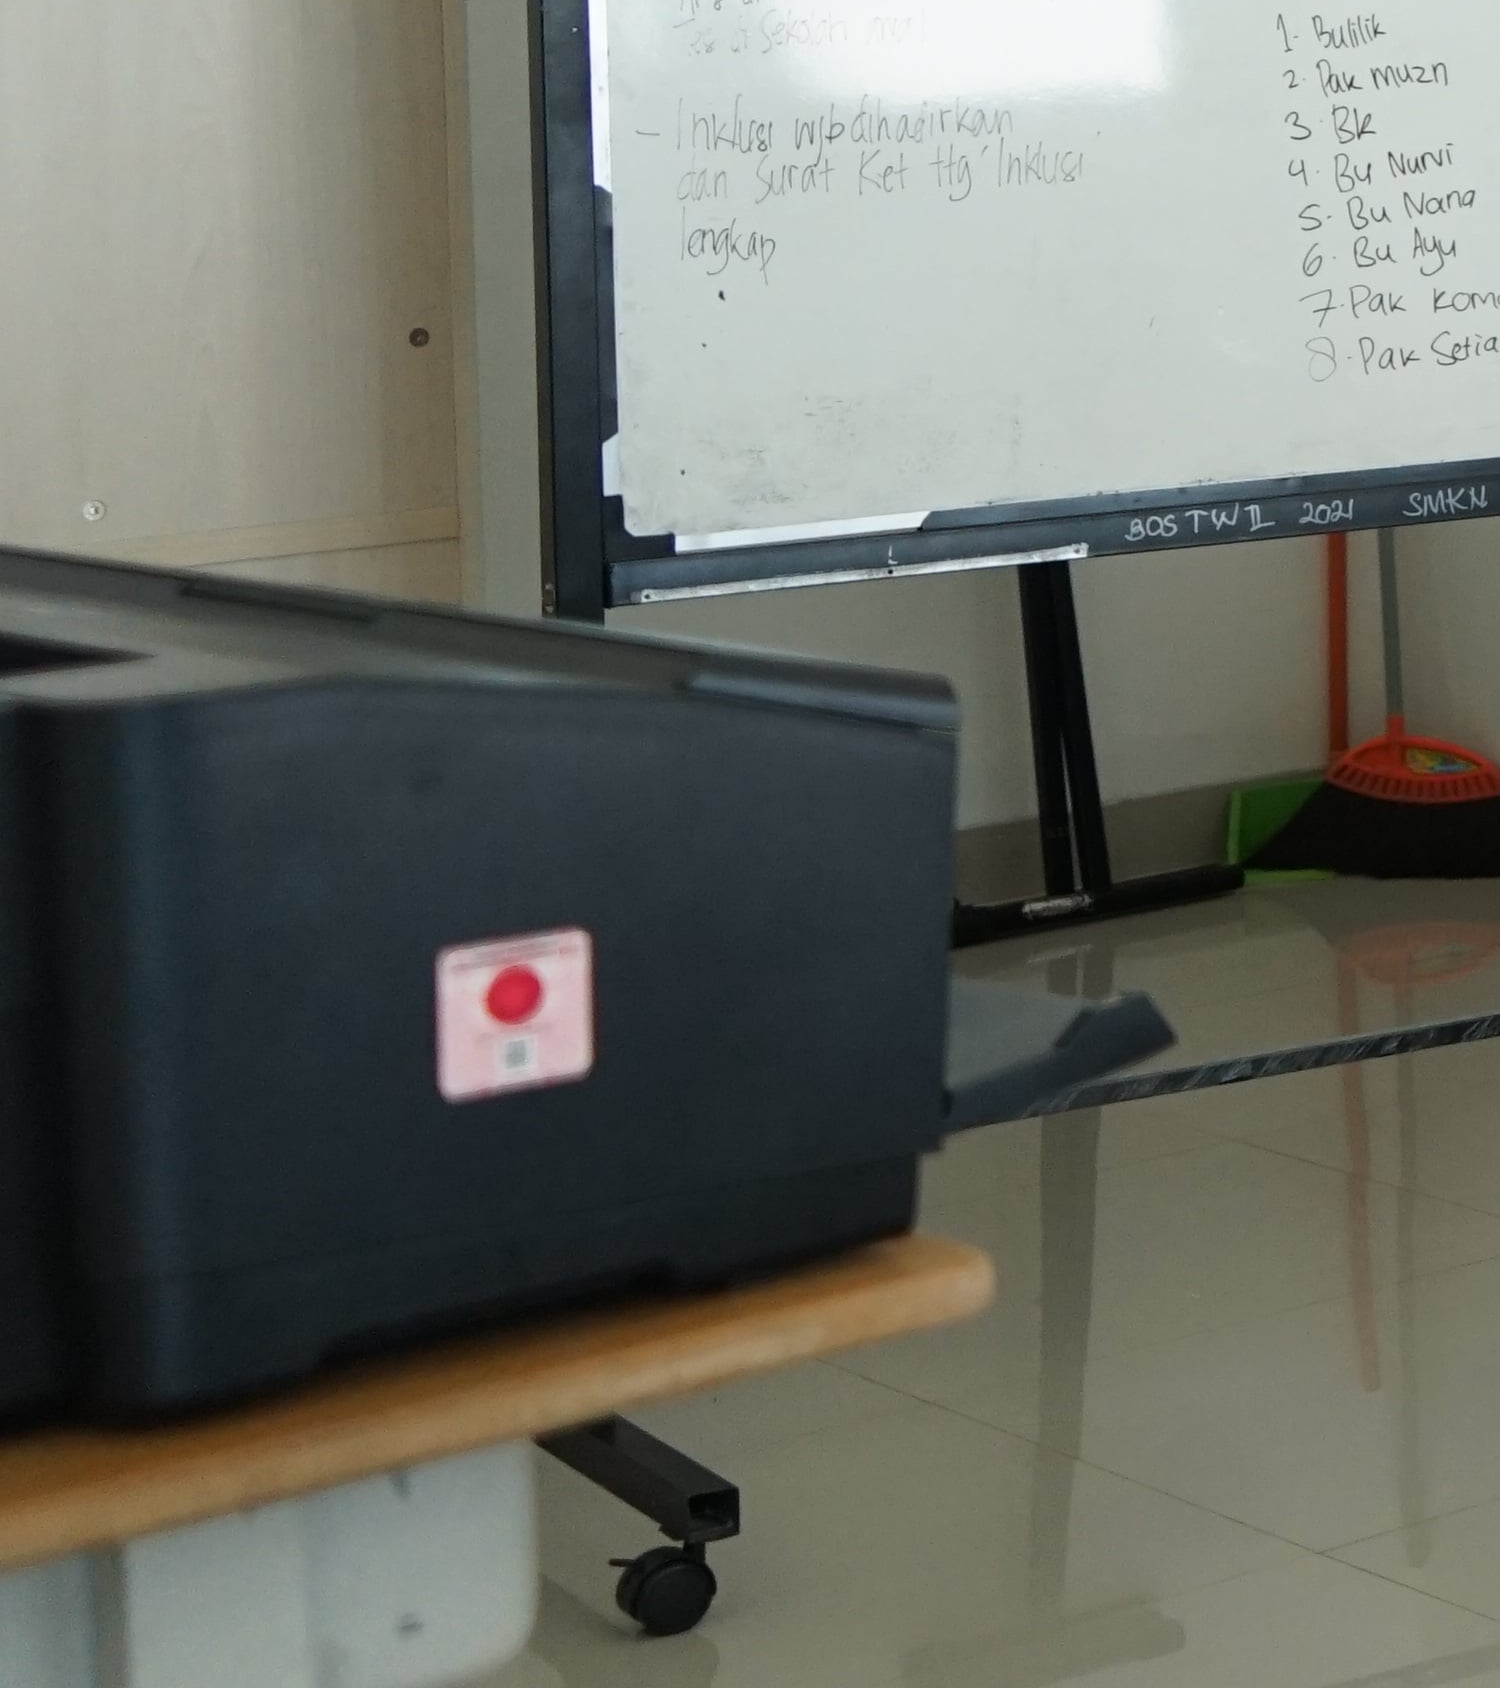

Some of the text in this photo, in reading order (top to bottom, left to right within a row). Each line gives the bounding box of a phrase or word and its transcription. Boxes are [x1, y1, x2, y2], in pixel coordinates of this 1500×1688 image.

[1316, 58, 1364, 98] Pak
[675, 157, 728, 201] dan
[754, 153, 836, 205] Surat
[858, 150, 909, 196] Ket
[1334, 153, 1373, 193] Bu
[1346, 195, 1392, 231] Bu
[1402, 189, 1477, 219] Nana
[680, 206, 776, 287] lengkap
[1353, 235, 1398, 268] Bu
[1413, 226, 1457, 276] Ayu
[1348, 284, 1406, 319] Pak
[1358, 336, 1421, 375] Pak
[1124, 514, 1178, 542] BOS
[1298, 498, 1354, 525] 2021
[1402, 484, 1489, 517] SMKN
